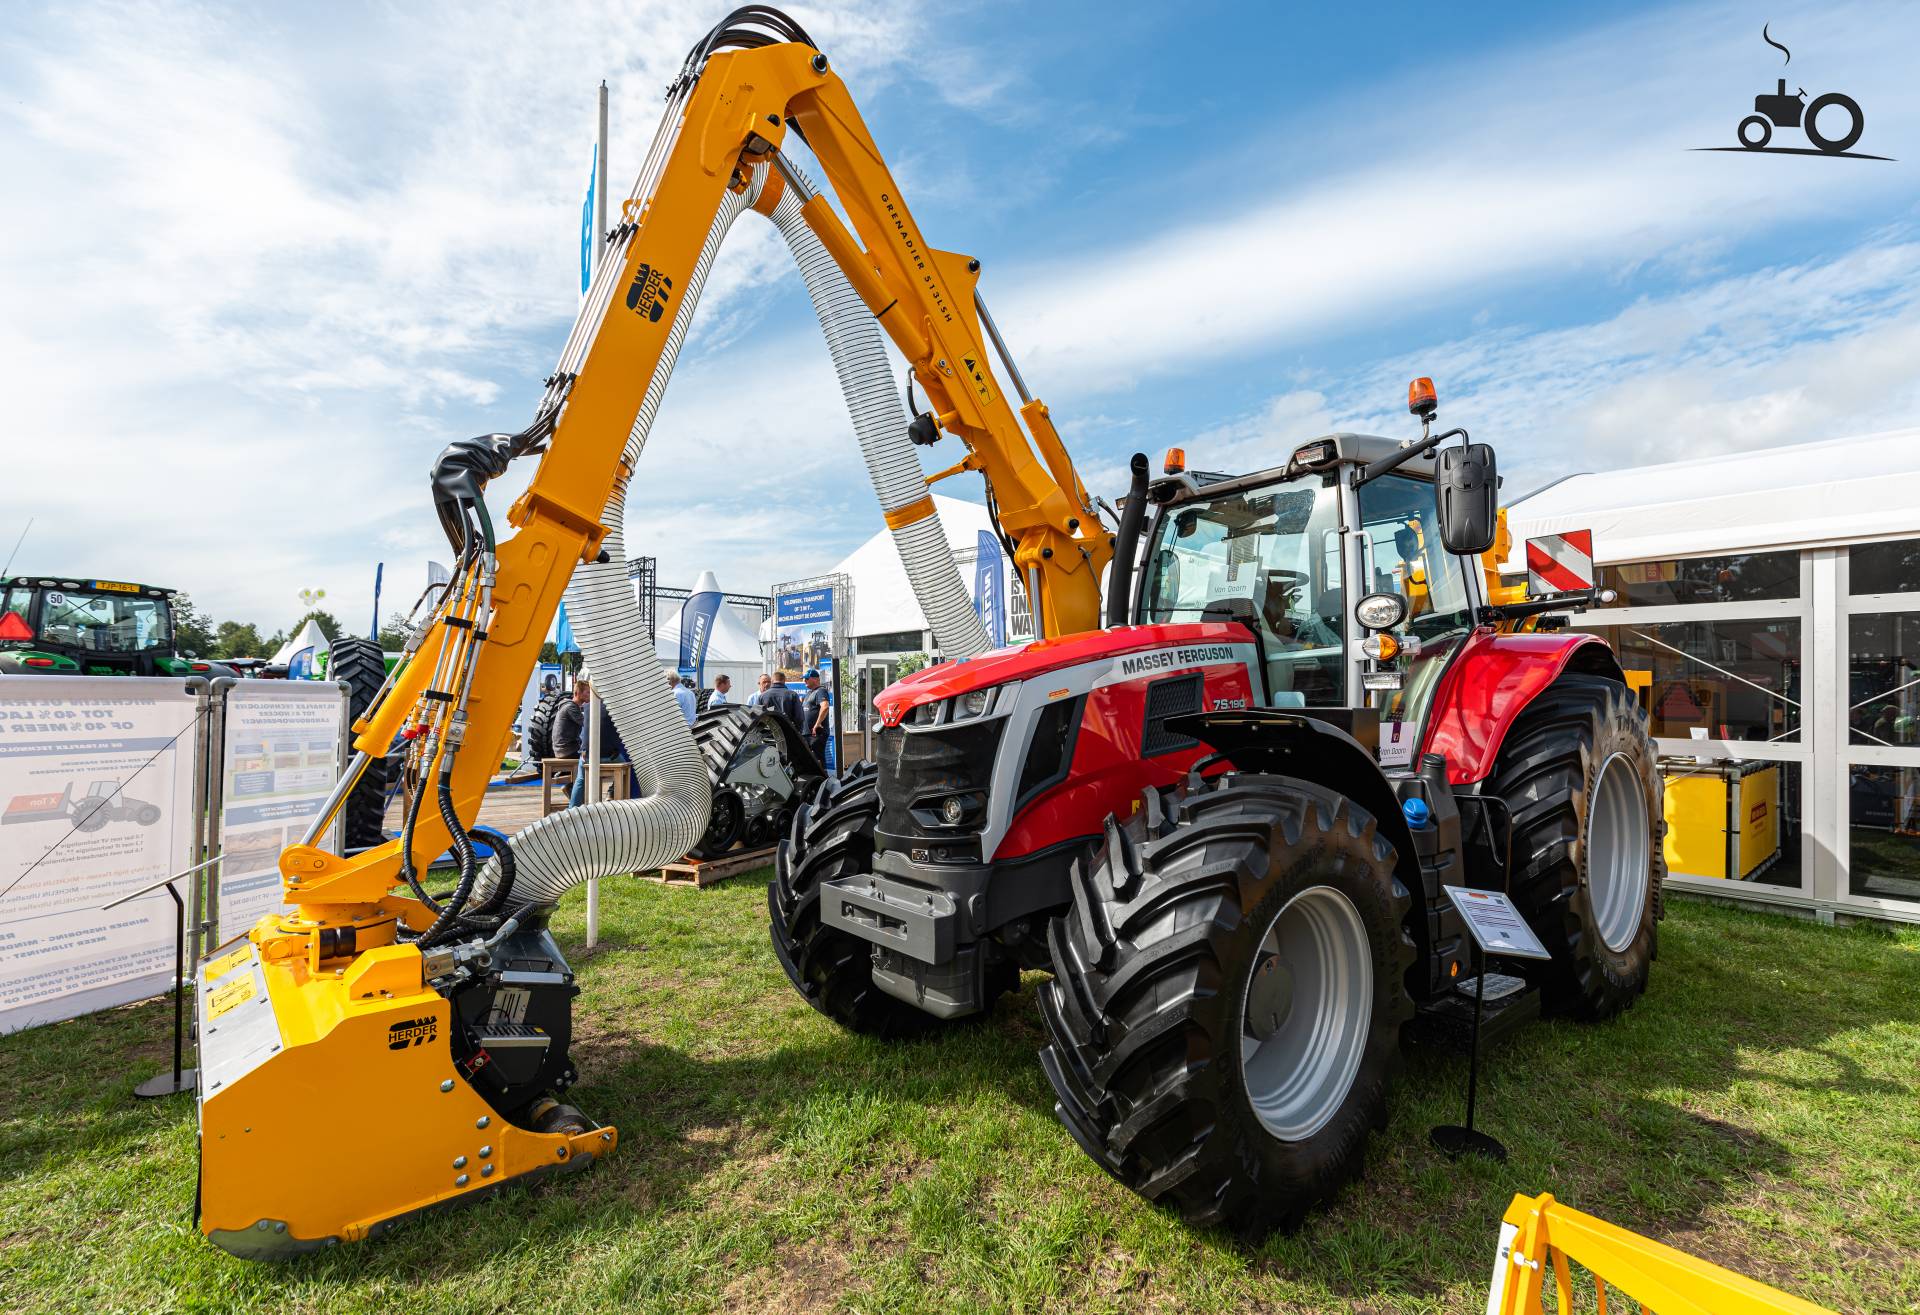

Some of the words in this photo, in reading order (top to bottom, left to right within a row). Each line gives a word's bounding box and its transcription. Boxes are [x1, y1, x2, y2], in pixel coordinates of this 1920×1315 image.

[882, 194, 924, 270] GRENADIER
[925, 276, 952, 322] 513LSH
[636, 269, 664, 319] HERDER
[51, 594, 63, 604] 50
[1122, 652, 1174, 675] MASSEY
[1177, 647, 1234, 664] FERGUSON
[388, 1025, 437, 1043] HERDER
